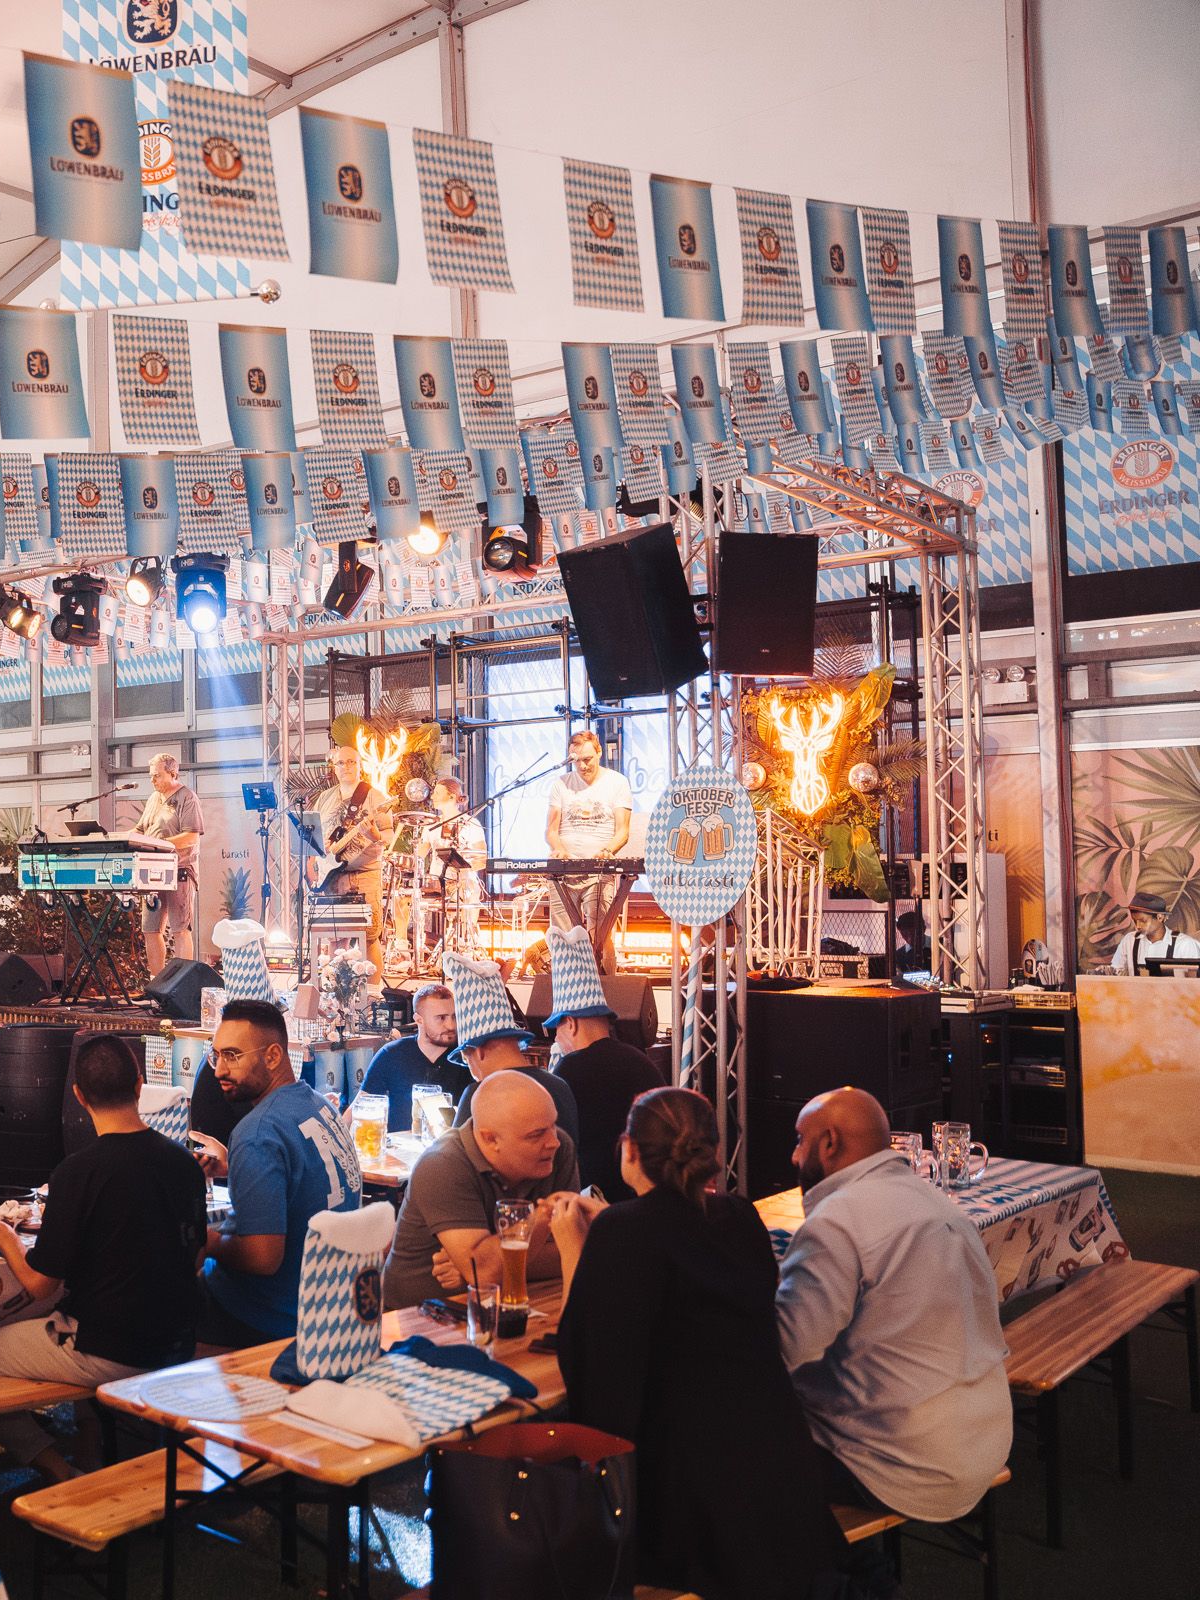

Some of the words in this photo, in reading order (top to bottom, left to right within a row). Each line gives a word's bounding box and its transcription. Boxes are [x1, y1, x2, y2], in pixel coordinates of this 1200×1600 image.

[199, 182, 257, 201] ERDINGER
[135, 387, 178, 400] ERDINGER
[330, 396, 368, 407] ERDINGER
[1114, 441, 1169, 469] ERDINGER
[1100, 489, 1192, 515] ERDINGER
[72, 510, 108, 520] ERDINGER
[190, 509, 222, 518] ERDINGER
[672, 788, 735, 806] OKTOBER
[686, 801, 720, 816] FEST
[221, 849, 250, 858] barasti
[506, 861, 538, 869] Roland
[678, 871, 734, 888] barasti
